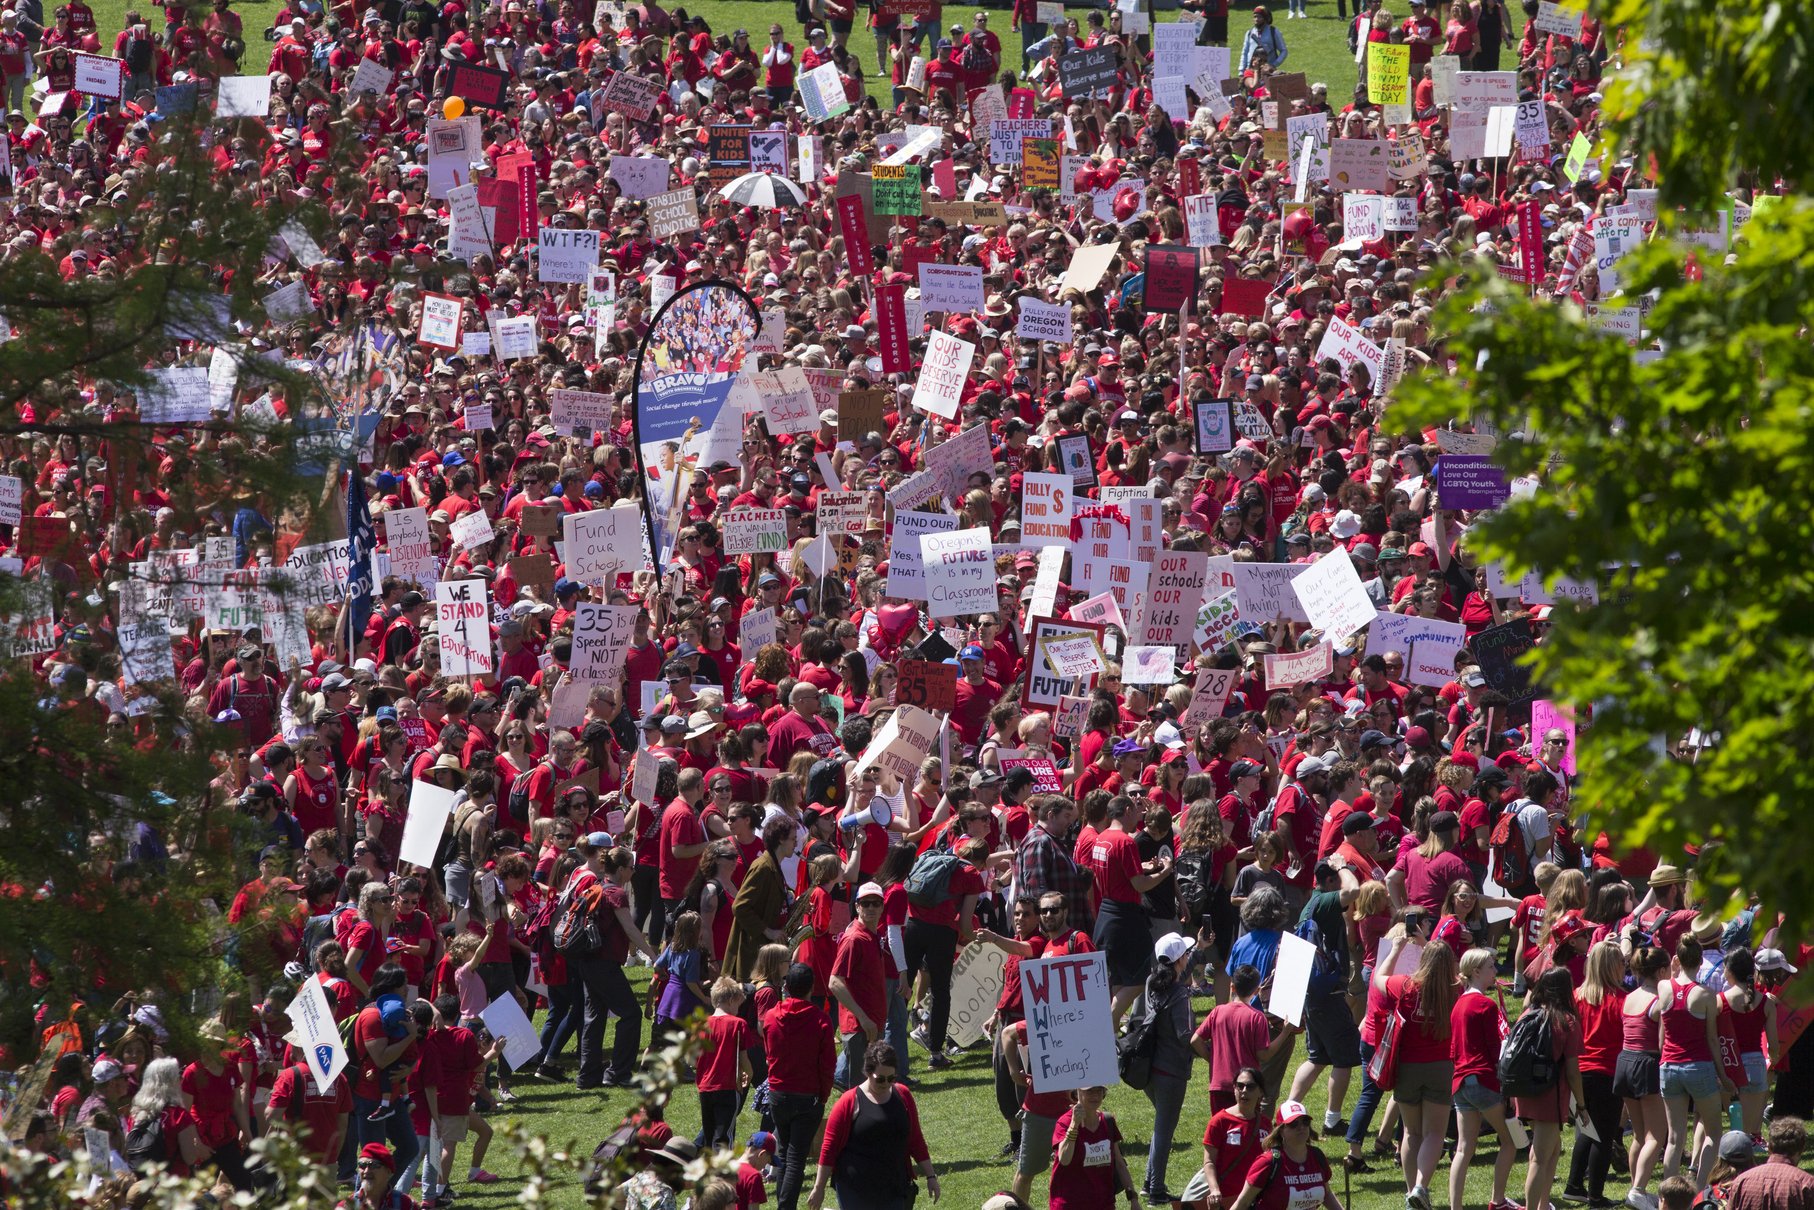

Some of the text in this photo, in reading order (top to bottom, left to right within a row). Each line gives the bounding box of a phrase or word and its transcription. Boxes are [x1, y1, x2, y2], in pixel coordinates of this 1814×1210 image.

[1062, 54, 1105, 72] Our Kids
[616, 73, 649, 91] Current
[1064, 69, 1116, 88] deserve more
[612, 82, 637, 98] Funding
[608, 92, 640, 106] Education
[1518, 102, 1540, 121] 35
[994, 120, 1046, 130] TEACHERS
[720, 138, 742, 148] FOR
[752, 136, 768, 148] Our
[992, 130, 1016, 140] JUST
[1000, 141, 1012, 150] TO
[716, 150, 745, 160] KIDS
[872, 165, 905, 178] STUDENTS
[646, 188, 694, 210] STABILIZE
[1184, 196, 1214, 215] WTF
[1397, 199, 1410, 210] Kids
[654, 205, 690, 222] SCHOOL
[847, 205, 857, 232] WEST
[1348, 204, 1370, 218] FUND
[653, 216, 698, 237] FUNDING
[1596, 226, 1630, 240] afford
[542, 259, 574, 270] Where's
[552, 270, 584, 282] Funding
[1023, 315, 1064, 328] OREGON
[1024, 308, 1066, 319] FULLY FUND
[886, 296, 899, 364] HILLSBORO
[1022, 324, 1064, 337] SCHOOLS
[1330, 322, 1352, 342] OUR
[934, 338, 962, 358] OUR
[932, 354, 957, 370] KIDS
[656, 374, 704, 391] BRAVO
[922, 364, 962, 387] DESERVE
[921, 380, 956, 400] BETTER
[646, 404, 661, 412] Social
[662, 401, 680, 410] change
[681, 398, 700, 408] through
[770, 404, 809, 422] Schools
[1024, 482, 1050, 497] FULLY
[1443, 480, 1496, 488] LGBTQ Youth.
[895, 482, 939, 511] SUPERHEROES
[1108, 488, 1147, 502] Fighting
[820, 507, 839, 517] is an
[1024, 502, 1046, 516] FUND
[1140, 504, 1152, 520] FUND
[394, 514, 412, 526] Is
[726, 522, 784, 533] JUST WANT TO
[896, 515, 953, 529] FUND OUR
[388, 530, 423, 543] anybody
[574, 516, 616, 541] Fund
[1023, 522, 1070, 538] EDUCATION
[1091, 522, 1112, 539] FUND
[212, 540, 228, 560] 35
[727, 535, 754, 551] Have
[928, 534, 982, 551] Oregon's
[390, 544, 431, 563] LISTENING
[893, 550, 914, 562] Yes,
[942, 550, 988, 564] FUTURE
[576, 558, 625, 575] Schools
[891, 568, 917, 578] THAT
[1161, 558, 1186, 572] OUR
[971, 568, 982, 580] my
[1109, 564, 1130, 583] FUND
[1158, 571, 1203, 588] schools
[448, 584, 470, 601] WE
[932, 584, 994, 601] Classroom!
[1153, 590, 1179, 604] OUR
[1262, 583, 1281, 596] NOT
[238, 594, 258, 604] THE
[440, 602, 484, 620] STAND
[1080, 602, 1106, 622] FUND
[1150, 610, 1178, 626] kids
[1194, 597, 1232, 630] KIDS
[579, 608, 626, 632] 35 is
[1204, 605, 1239, 637] need
[1378, 617, 1408, 630] Invest
[454, 620, 467, 640] 4
[1147, 628, 1172, 641] OUR
[1380, 628, 1406, 642] in our
[576, 634, 629, 653] Speed limit
[1063, 640, 1091, 654] STUDENTS
[1403, 632, 1463, 647] COMMUNITY!
[440, 634, 491, 670] EDUCATION
[591, 648, 619, 664] NOT
[1060, 653, 1088, 663] DESERVE
[570, 664, 607, 679] a class
[1062, 659, 1099, 675] BETTER!
[1419, 664, 1454, 677] SCHOOLS
[896, 677, 927, 704] 35
[1032, 676, 1086, 697] FUTUE
[1198, 674, 1228, 695] 28
[1004, 760, 1050, 768] FUND OUR
[1036, 776, 1056, 784] OUR
[1025, 958, 1106, 1005] WTF?!
[1032, 1004, 1084, 1031] Where's
[1036, 1032, 1063, 1050] The
[318, 1046, 331, 1067] PAT
[1040, 1047, 1090, 1080] Funding?
[1090, 1144, 1105, 1153] NOT
[1284, 1173, 1323, 1185] THIS OREGON
